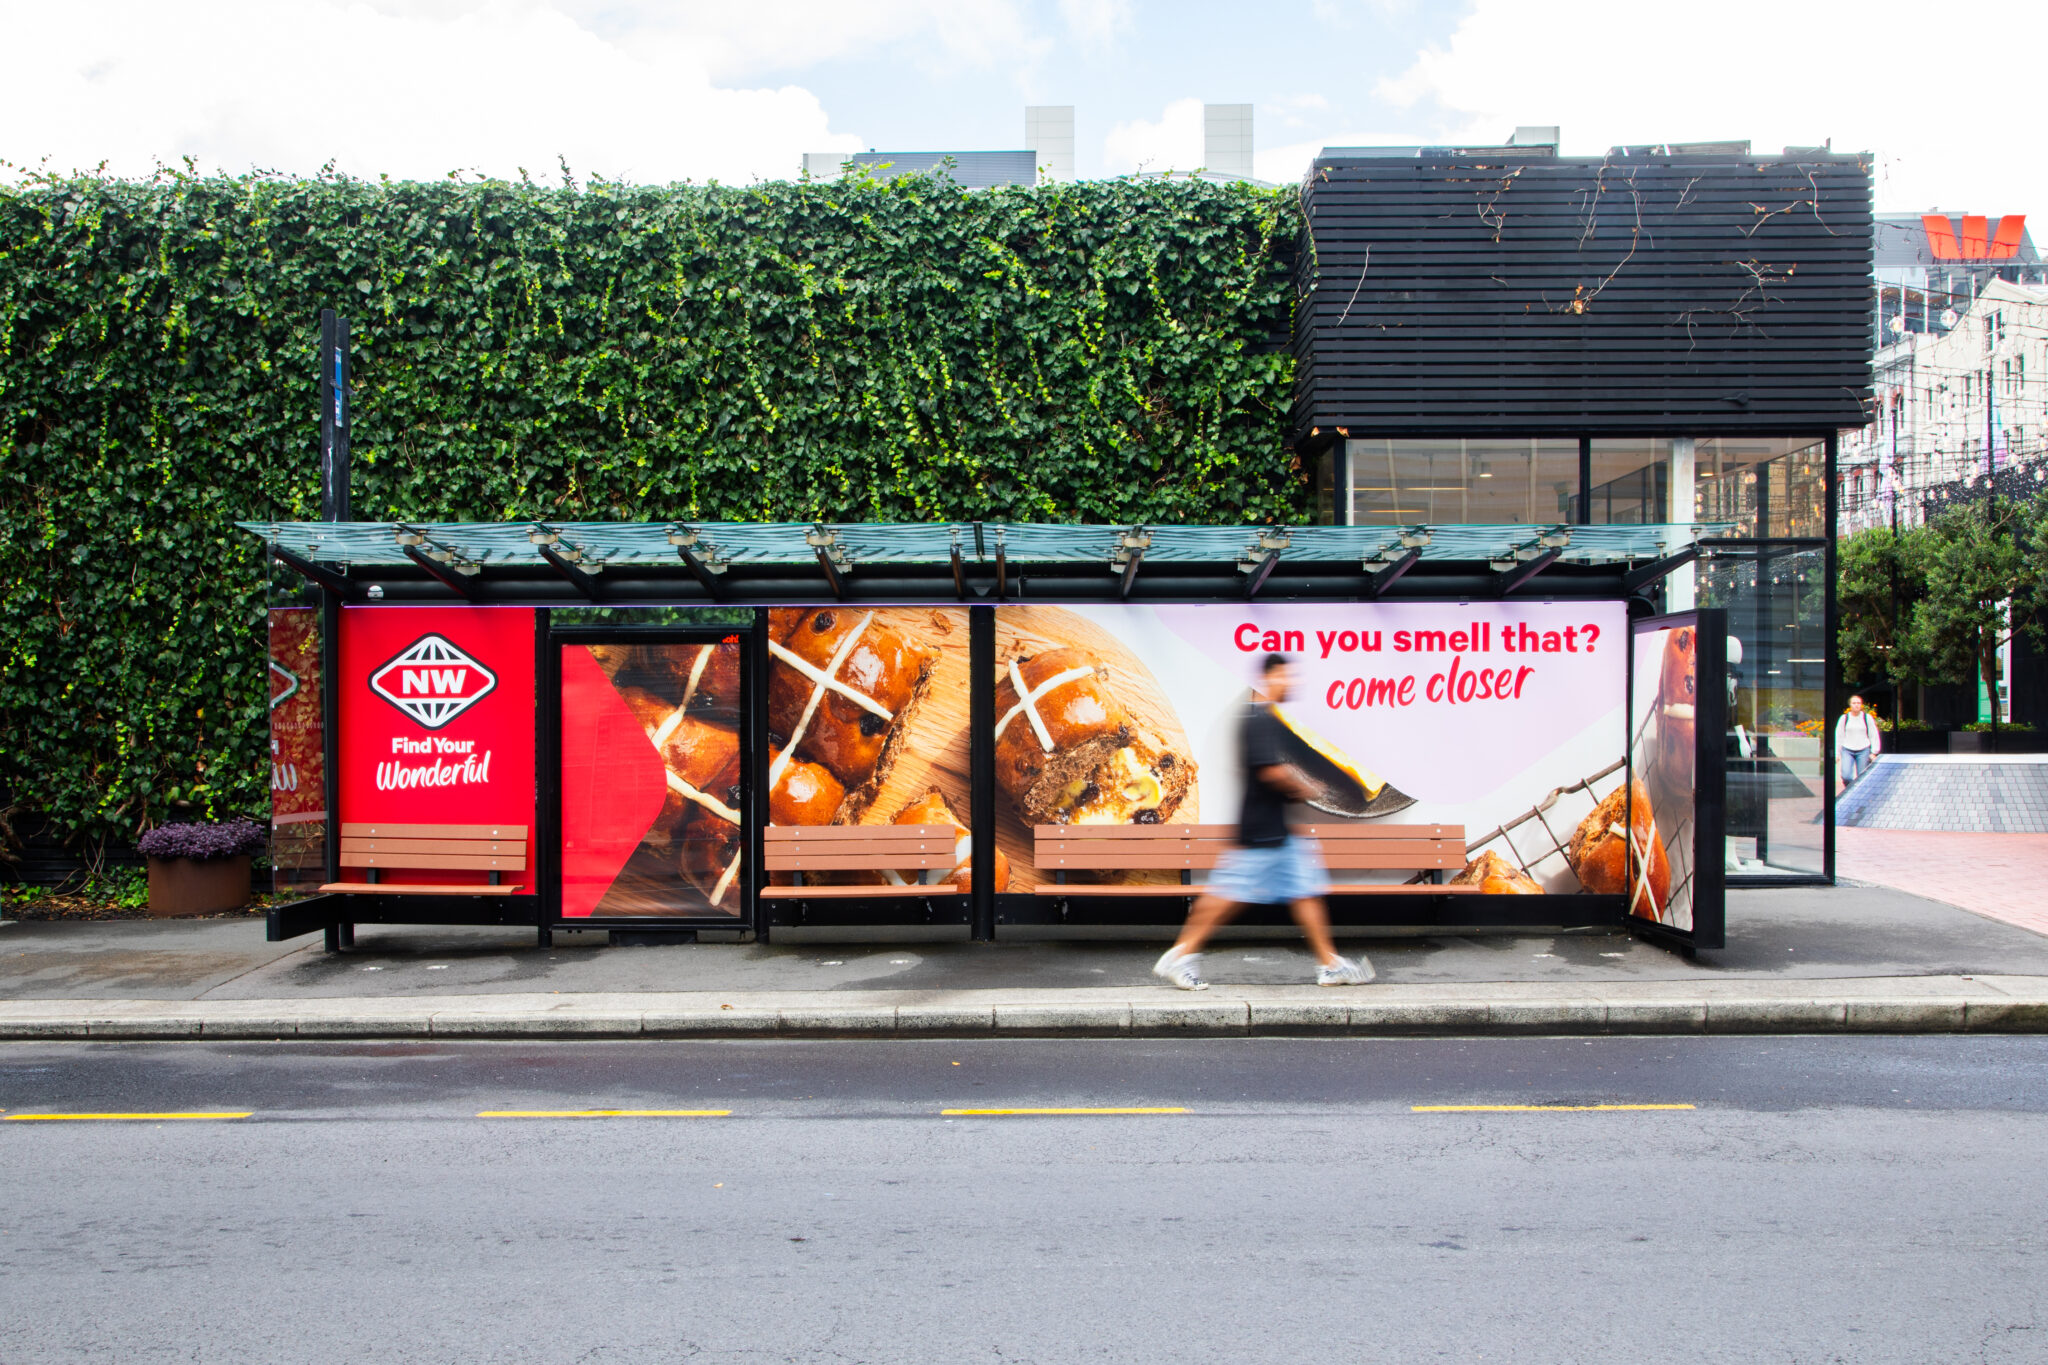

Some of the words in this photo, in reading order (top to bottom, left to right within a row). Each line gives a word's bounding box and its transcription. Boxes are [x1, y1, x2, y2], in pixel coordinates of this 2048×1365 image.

[1233, 622, 1305, 653] Can
[1316, 630, 1383, 660] you
[1393, 621, 1491, 653] smell
[1501, 622, 1601, 653] that?
[402, 669, 467, 694] NW
[1325, 674, 1417, 711] come
[1425, 655, 1536, 706] closer
[391, 737, 432, 754] Find
[432, 738, 475, 754] Your
[376, 750, 492, 791] Wonderful
